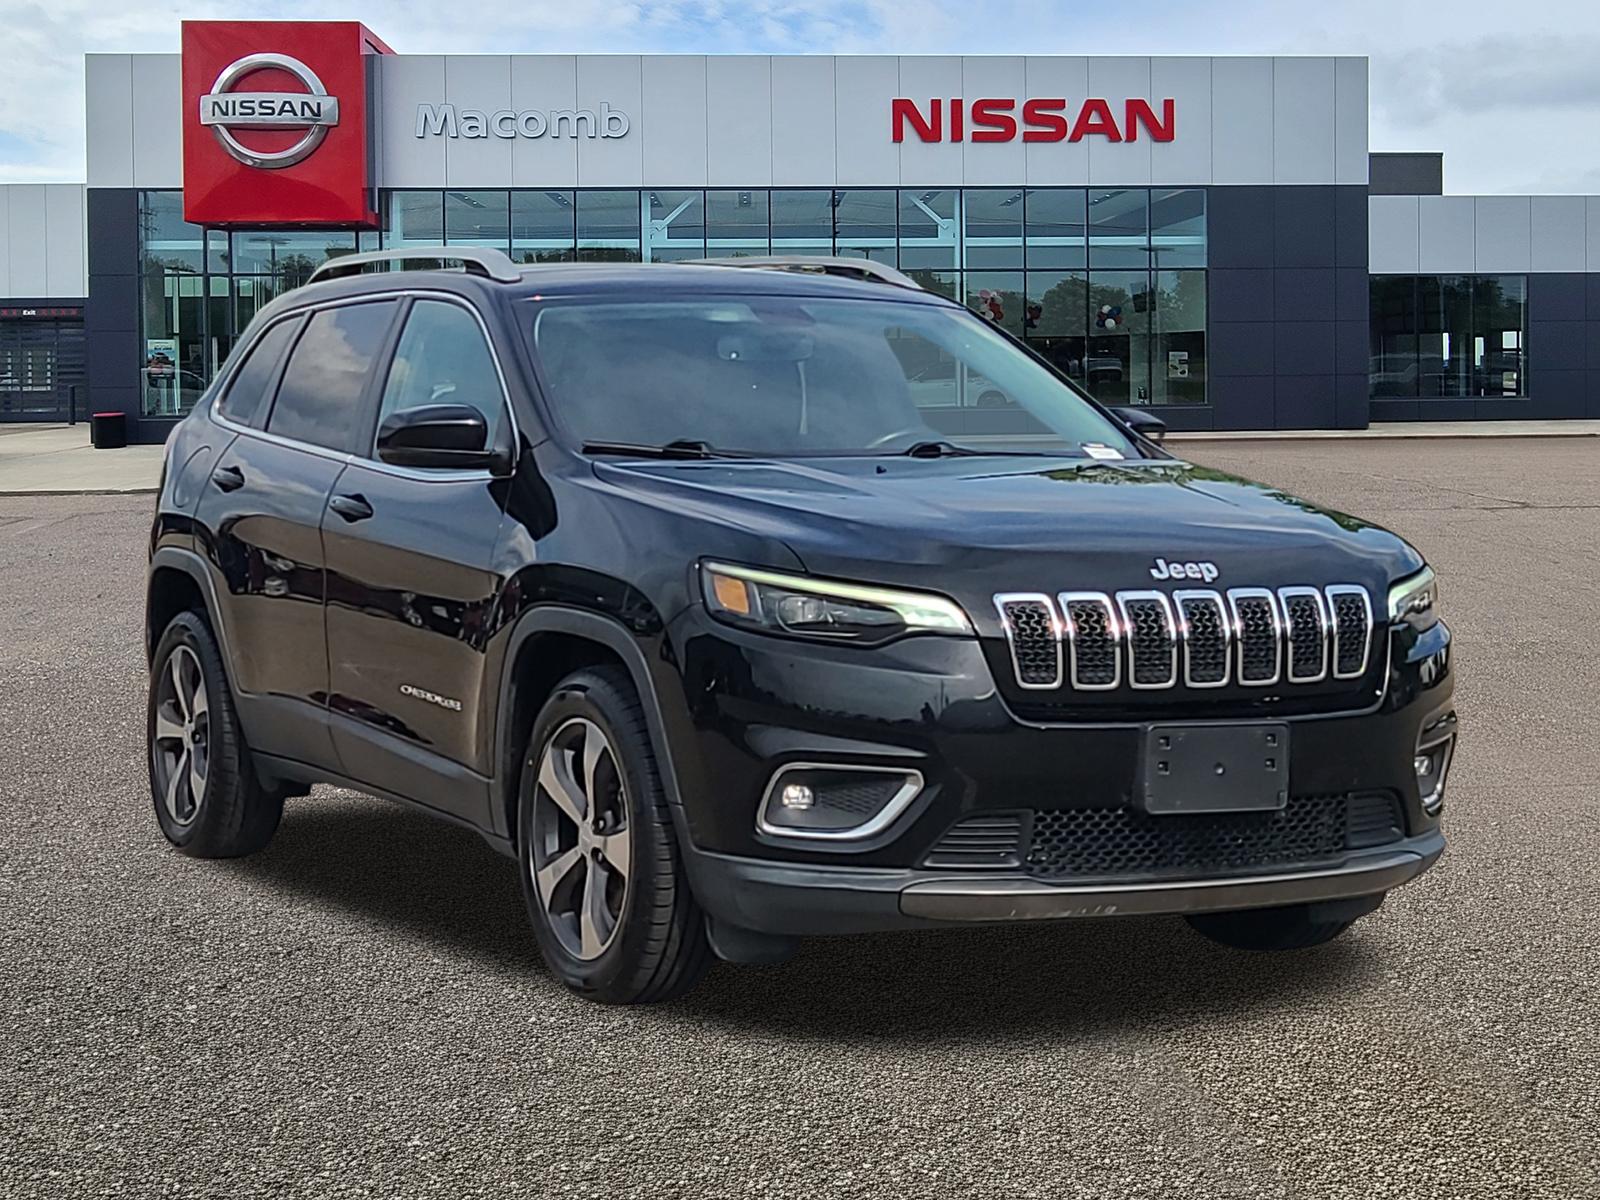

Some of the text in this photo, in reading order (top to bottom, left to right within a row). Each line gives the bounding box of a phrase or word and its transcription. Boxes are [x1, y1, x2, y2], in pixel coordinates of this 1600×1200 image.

[211, 99, 322, 118] NISSAN
[415, 102, 630, 139] Macomb
[891, 98, 1175, 143] NISSAN
[1149, 558, 1219, 583] Jeep
